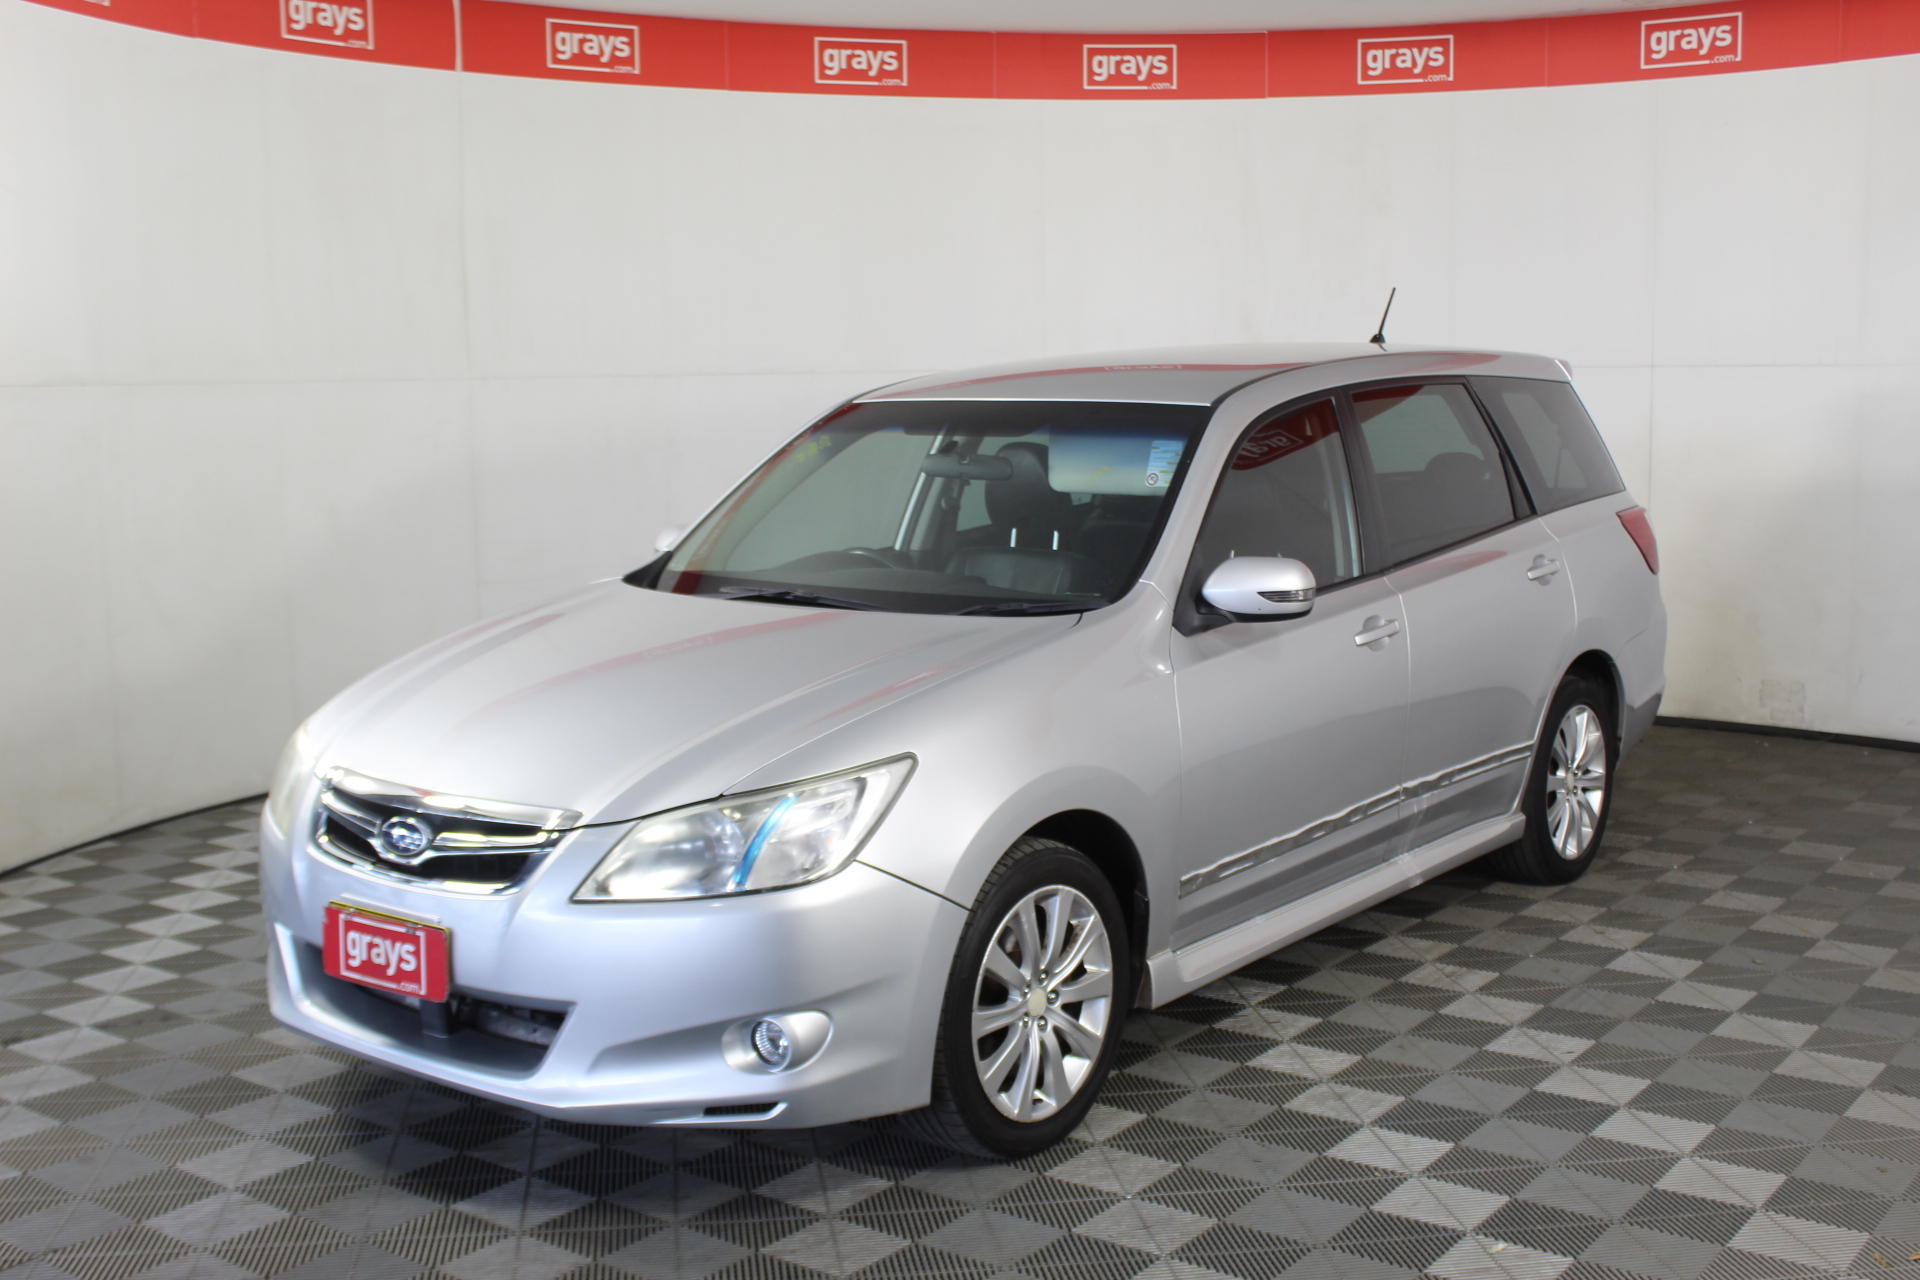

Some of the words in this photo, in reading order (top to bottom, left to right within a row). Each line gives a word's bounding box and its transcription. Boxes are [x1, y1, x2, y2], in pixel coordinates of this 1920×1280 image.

[288, 0, 365, 35] grays
[556, 31, 631, 62] grays
[1649, 25, 1732, 60] grays
[823, 48, 898, 76] grays
[1092, 55, 1168, 80] grays
[1366, 46, 1444, 76] grays
[1710, 53, 1735, 64] .com
[346, 930, 417, 976] grays
[397, 981, 420, 994] .com
